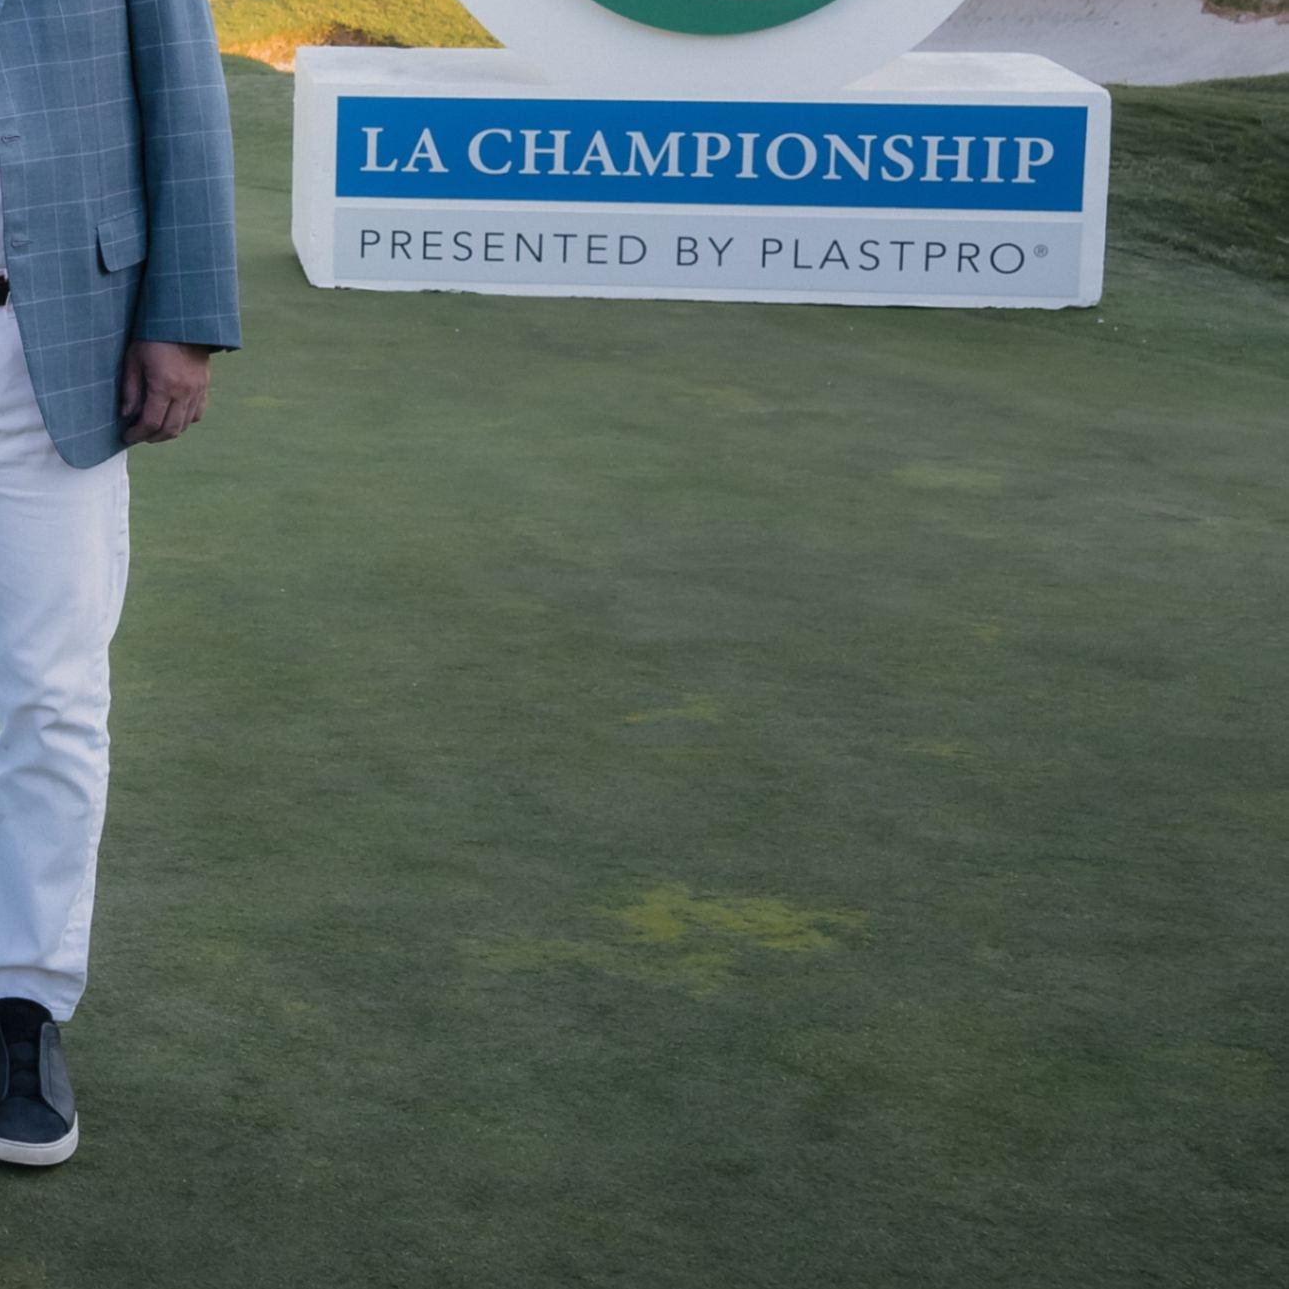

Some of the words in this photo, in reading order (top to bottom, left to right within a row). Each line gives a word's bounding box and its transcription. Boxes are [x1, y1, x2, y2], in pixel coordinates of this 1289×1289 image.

[362, 128, 448, 175] LA
[468, 129, 1055, 184] CHAMPIONSHIP
[360, 229, 648, 266] PRESENTED
[677, 236, 734, 267] BY
